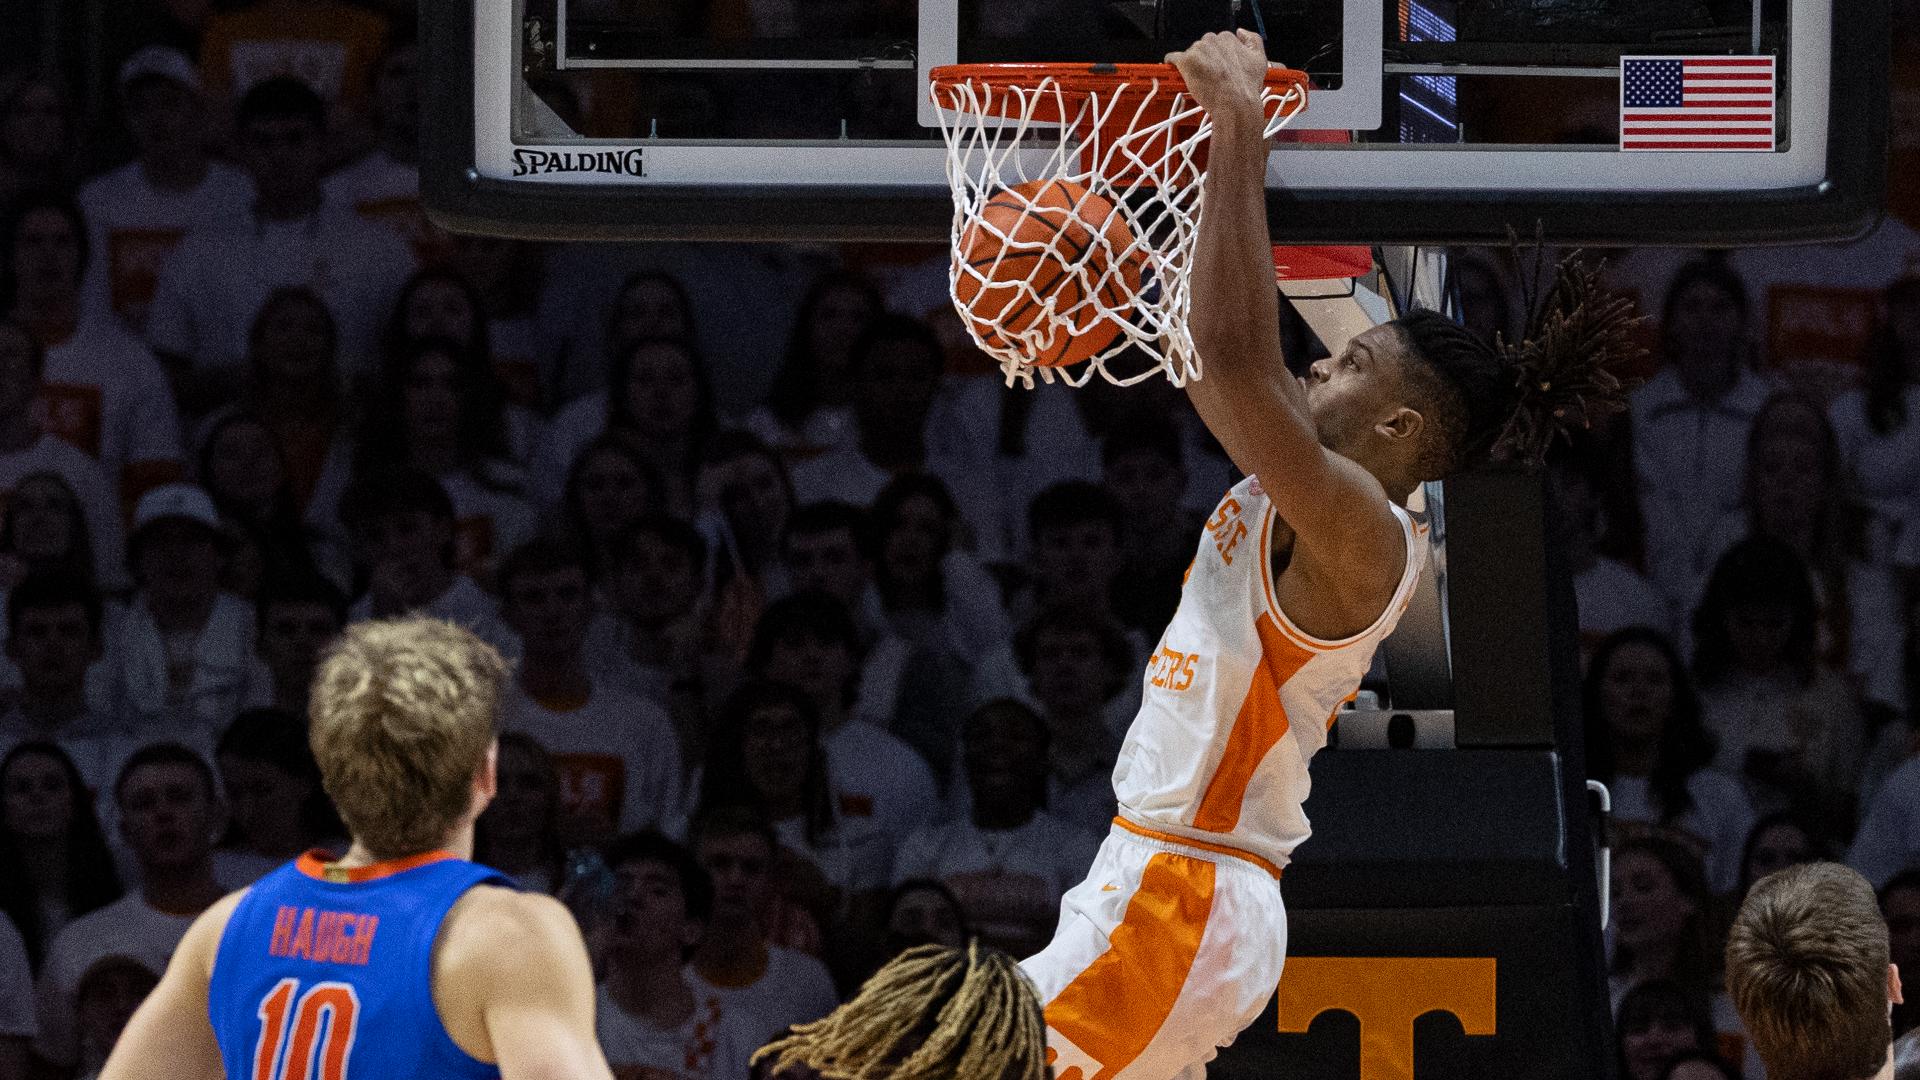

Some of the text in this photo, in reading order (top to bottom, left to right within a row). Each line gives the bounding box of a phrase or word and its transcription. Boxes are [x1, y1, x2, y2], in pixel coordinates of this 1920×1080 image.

[512, 148, 643, 177] SPALDING
[269, 905, 379, 965] HAUGH
[251, 977, 361, 1080] 10
